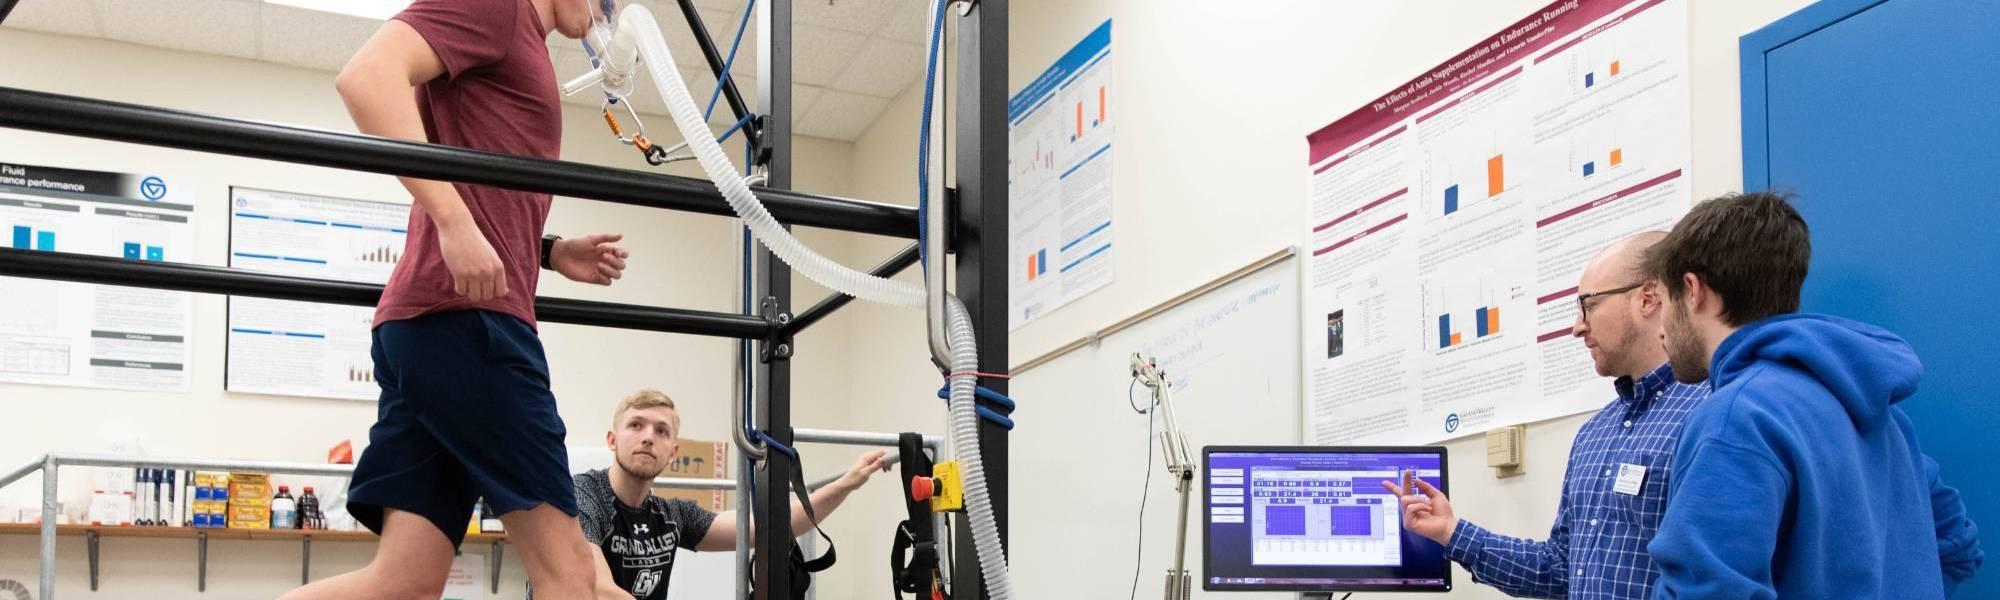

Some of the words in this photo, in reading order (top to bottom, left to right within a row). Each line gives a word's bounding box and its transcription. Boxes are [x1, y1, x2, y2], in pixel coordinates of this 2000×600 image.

[1373, 102, 1387, 112] The
[1385, 90, 1408, 106] Effects
[1408, 84, 1415, 94] of
[1432, 45, 1490, 80] Supplementation
[1490, 41, 1500, 50] on
[1500, 18, 1542, 45] Endurance
[1542, 0, 1579, 22] Running
[2, 165, 25, 176] Fluid
[27, 179, 85, 192] performance
